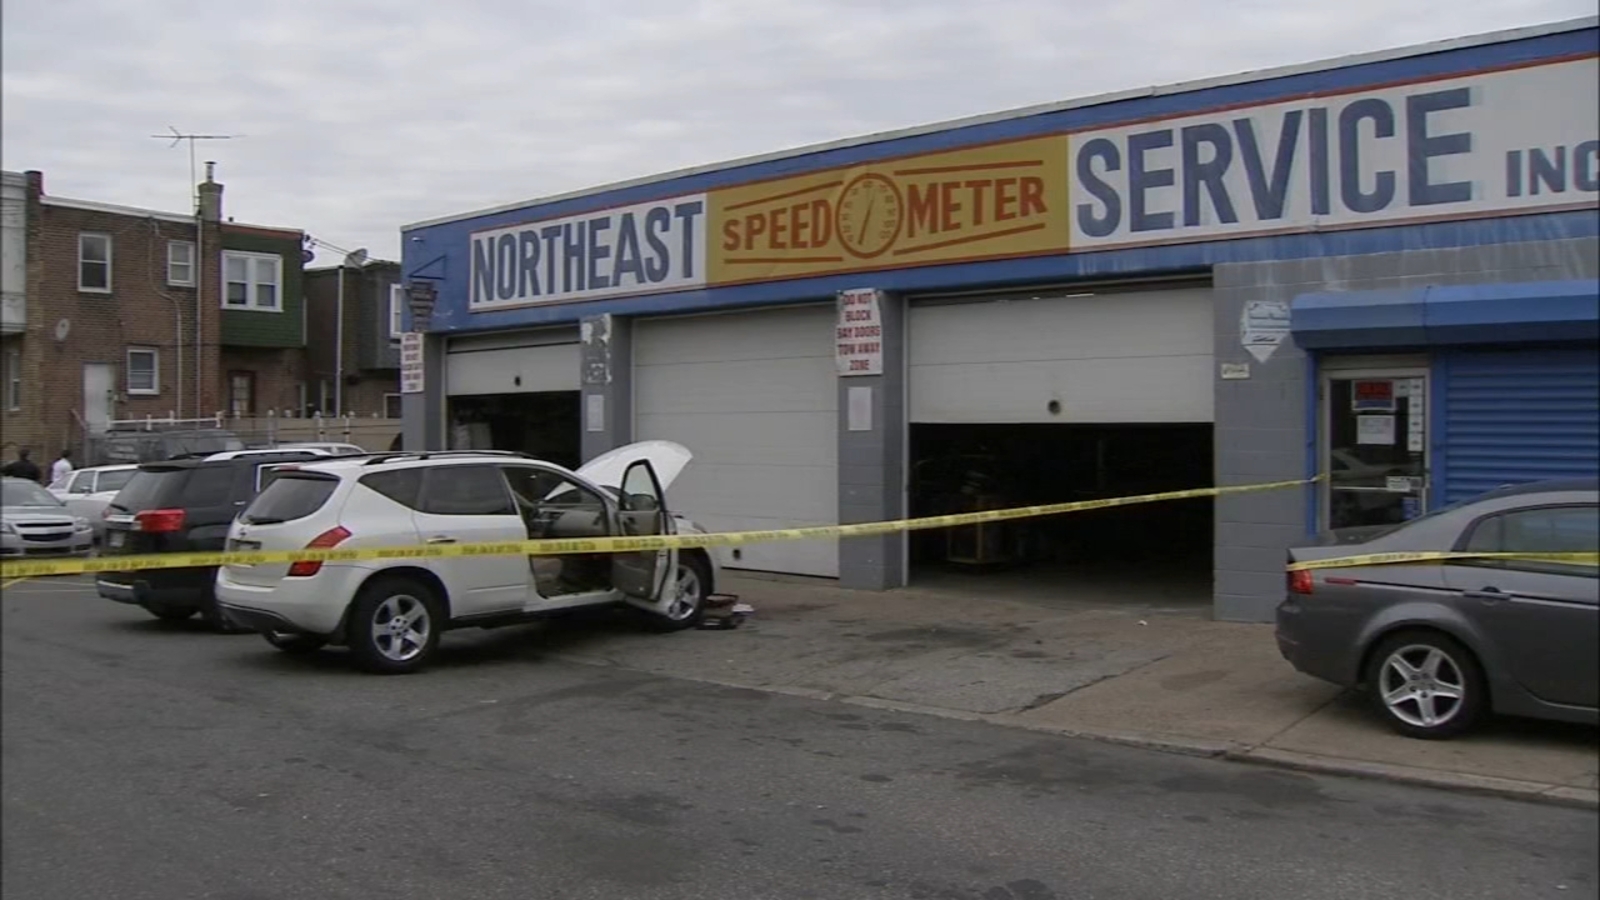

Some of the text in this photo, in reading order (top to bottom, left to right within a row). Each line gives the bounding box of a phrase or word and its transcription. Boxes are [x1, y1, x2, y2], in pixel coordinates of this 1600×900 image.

[1076, 87, 1471, 237] SERVICE
[723, 199, 832, 251] SPEED
[907, 176, 1047, 239] METER
[473, 201, 703, 304] NORTHEAST
[842, 292, 873, 305] DO NOT
[845, 310, 872, 322] BLOCK
[855, 325, 881, 337] DOORS
[838, 341, 880, 356] TOW AWAY
[850, 359, 870, 371] ZONE
